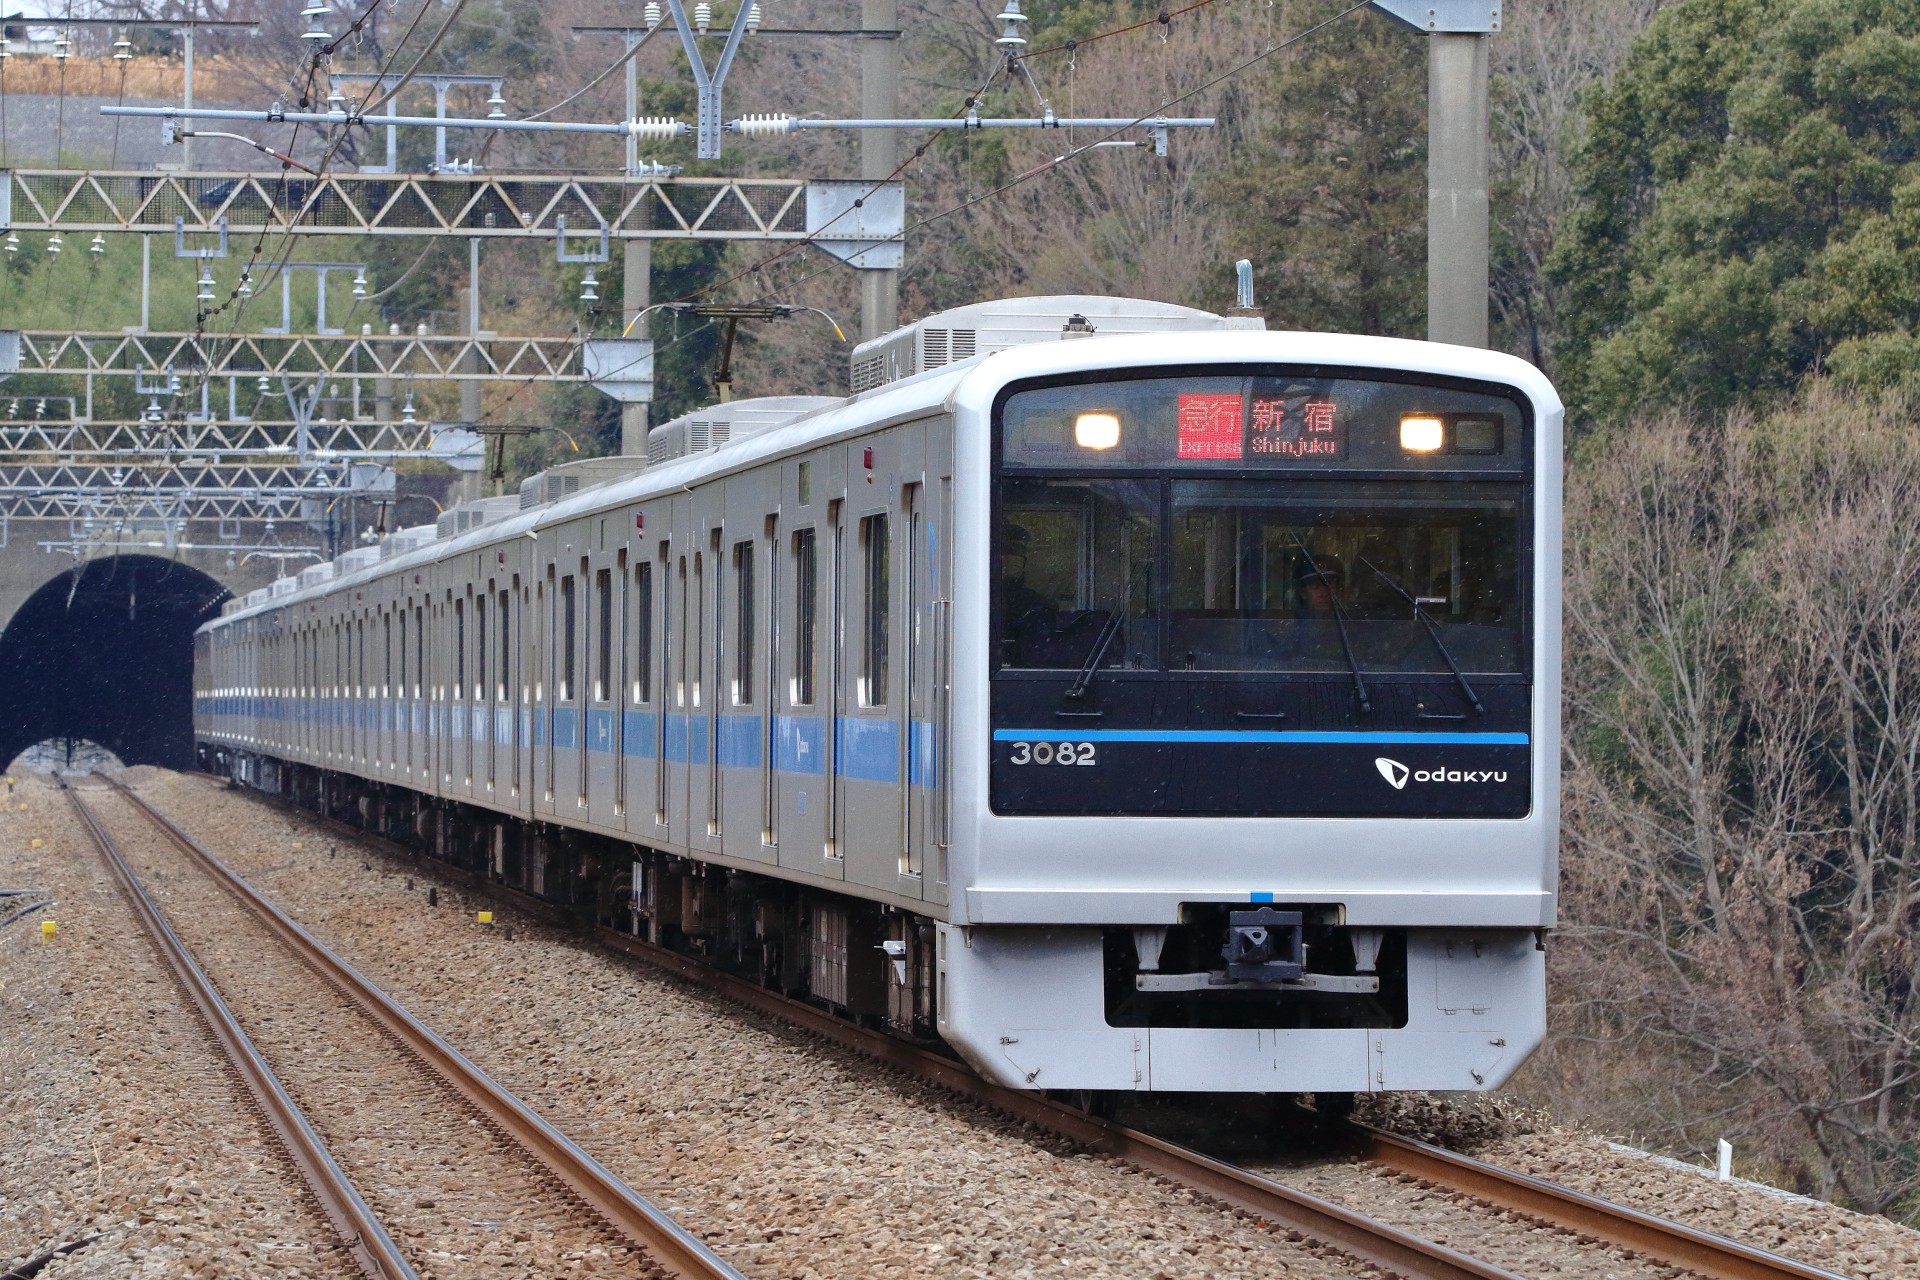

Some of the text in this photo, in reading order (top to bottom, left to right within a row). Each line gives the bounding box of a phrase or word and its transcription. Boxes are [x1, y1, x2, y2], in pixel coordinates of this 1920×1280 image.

[1180, 400, 1240, 432] 急行
[1252, 400, 1337, 432] 新宿
[1178, 437, 1242, 454] Express
[1252, 436, 1335, 457] Shinjuku
[1010, 741, 1096, 766] 3082
[1414, 766, 1508, 783] odakyu
